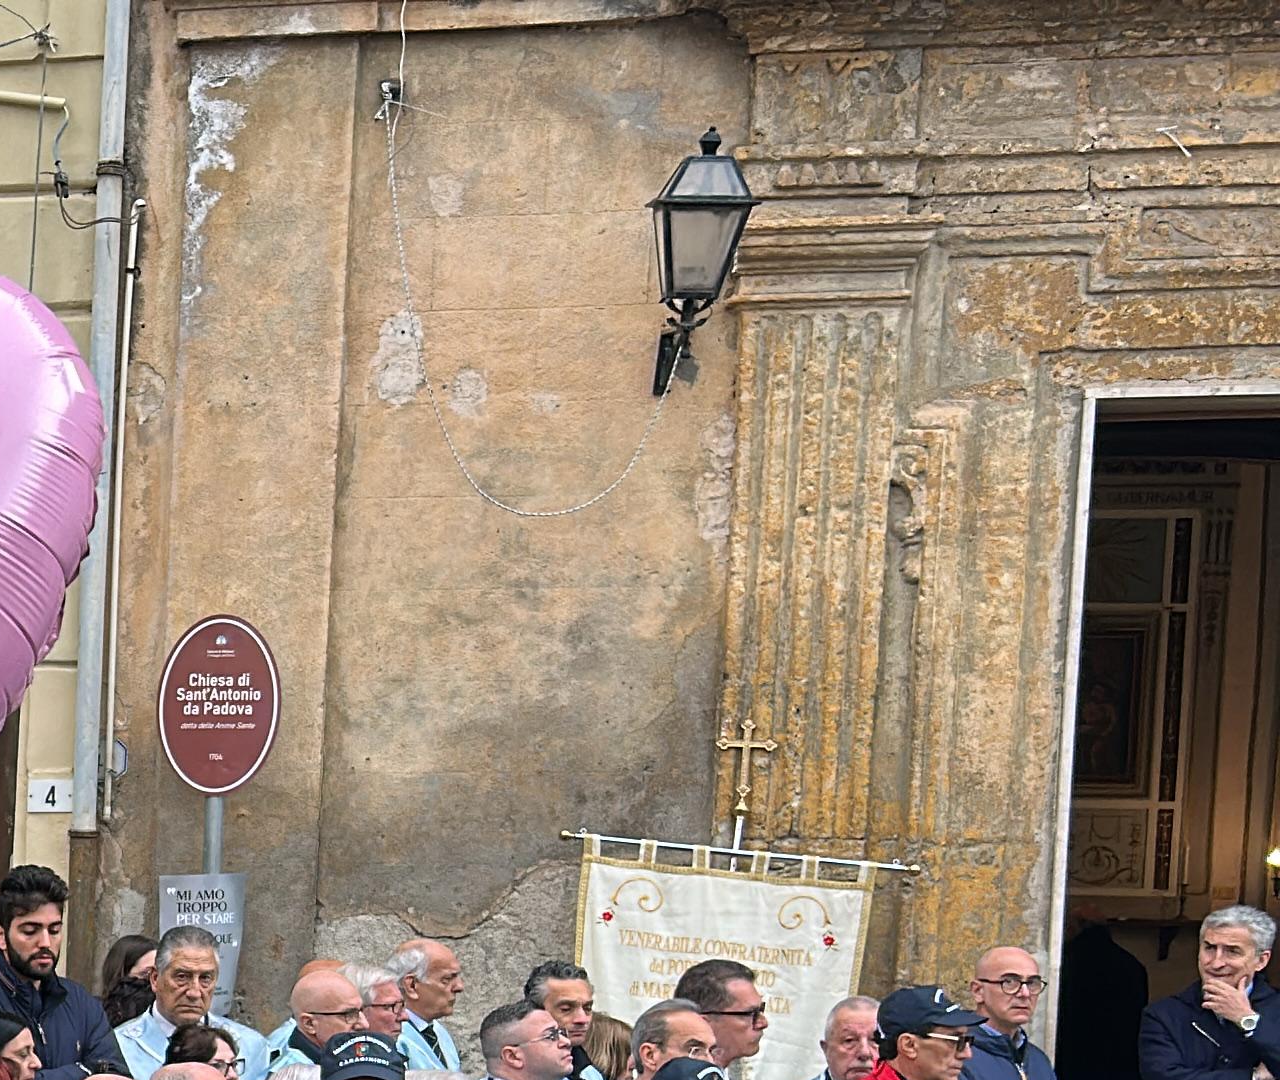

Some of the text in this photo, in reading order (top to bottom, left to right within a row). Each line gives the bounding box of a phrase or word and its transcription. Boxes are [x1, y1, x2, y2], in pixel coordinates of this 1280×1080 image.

[189, 673, 250, 686] Chiesa di
[176, 687, 261, 701] Sant'Antonio
[183, 702, 253, 715] da Padova
[45, 785, 56, 807] 4
[196, 889, 225, 901] AMO
[176, 901, 228, 913] TROPPO
[176, 912, 235, 925] PER STARE
[619, 929, 813, 966] VENERABILE CONFRATERNITA
[650, 957, 664, 974] del
[629, 980, 640, 996] di
